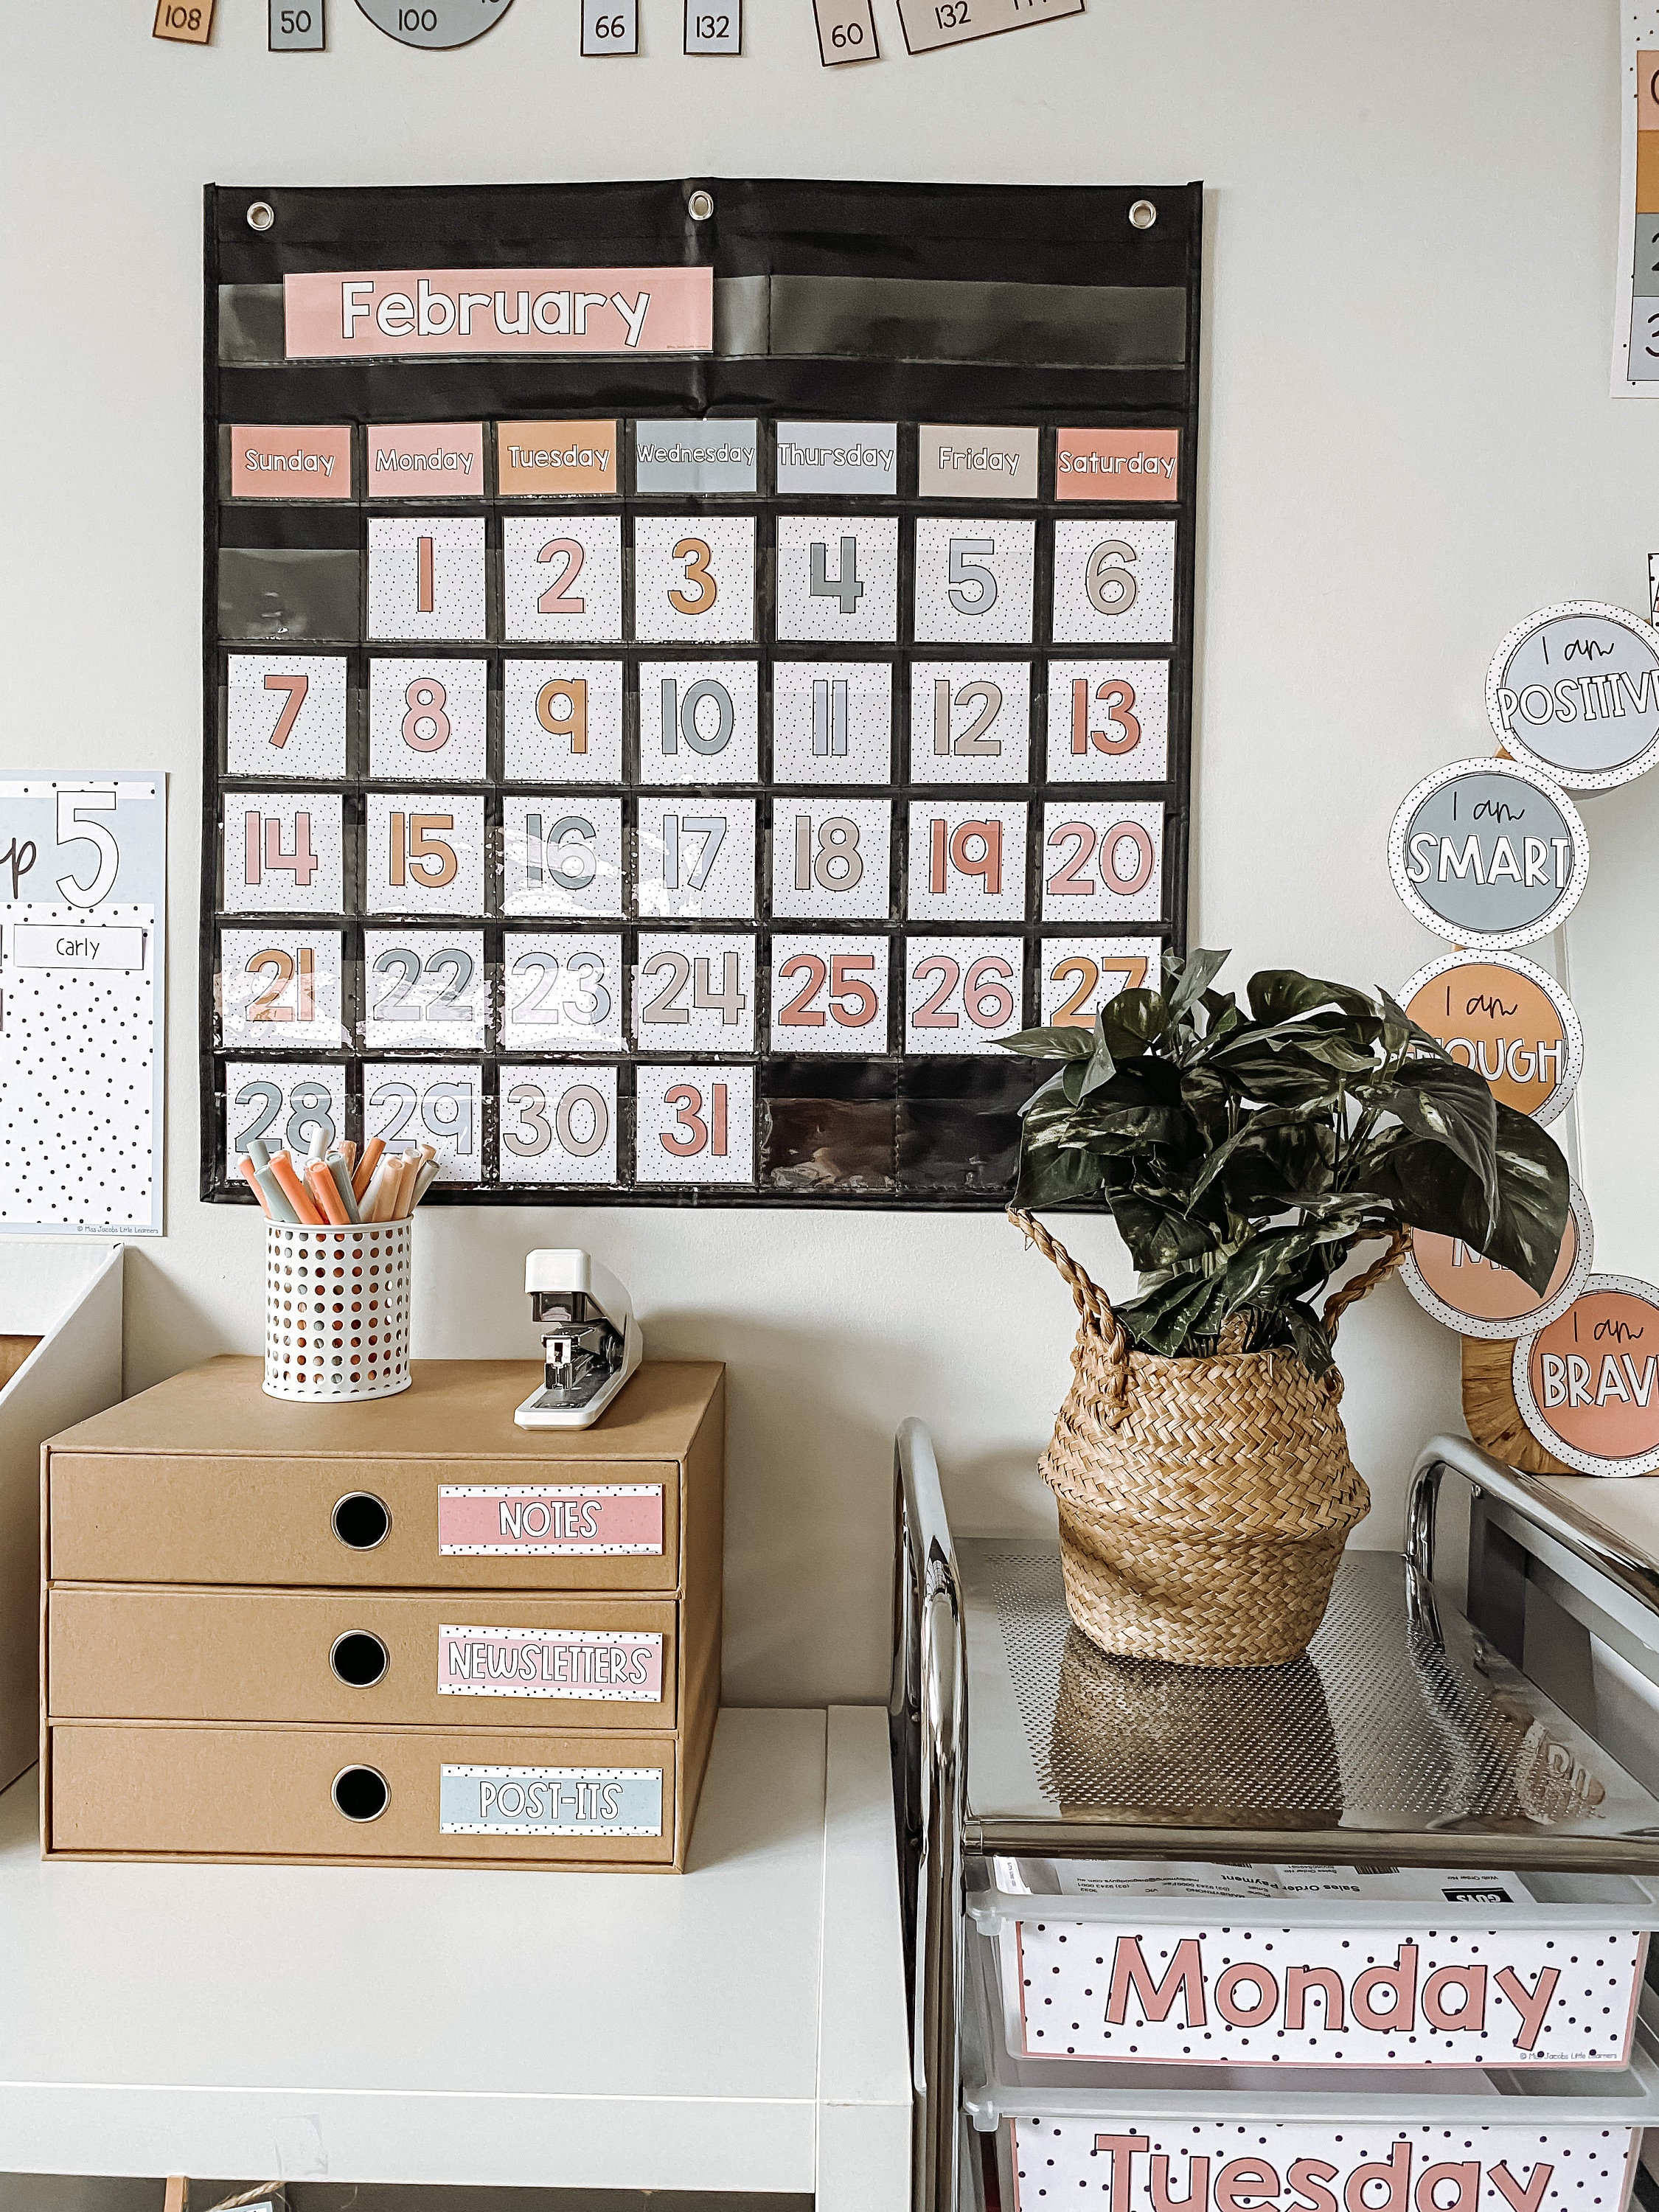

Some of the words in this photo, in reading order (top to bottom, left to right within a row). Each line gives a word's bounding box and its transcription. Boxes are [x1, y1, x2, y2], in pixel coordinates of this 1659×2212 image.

[165, 5, 201, 30] 108
[281, 10, 311, 33] 50
[398, 9, 437, 31] 100
[594, 15, 625, 38] 66
[696, 15, 729, 39] 132
[832, 22, 863, 48] 60
[935, 1, 971, 29] 132
[341, 279, 650, 347] February
[245, 448, 335, 476] Sunday
[375, 448, 473, 474] Monday
[508, 445, 611, 471] Tuesday
[637, 444, 755, 466] Wednesday
[776, 443, 894, 471] Thursday
[939, 446, 1020, 475] Friday
[1059, 451, 1175, 479] Saturday
[417, 537, 433, 612] 1
[537, 538, 586, 613] 2
[667, 538, 717, 615] 3
[810, 536, 863, 613] 4
[947, 538, 998, 615] 5
[1086, 540, 1138, 615] 6
[1542, 636, 1548, 664] I
[1565, 639, 1615, 661] am
[264, 675, 308, 748] 7
[402, 678, 451, 752] 8
[535, 678, 588, 754] 9
[661, 678, 734, 755] 10
[813, 680, 848, 757] 11
[933, 680, 1003, 756] 12
[1071, 678, 1141, 755] 13
[1453, 791, 1458, 821] I
[1473, 800, 1525, 824] am
[56, 791, 119, 908] 5
[245, 811, 318, 886] 14
[389, 812, 457, 888] 15
[526, 814, 597, 891] 16
[663, 815, 726, 891] 17
[795, 815, 863, 891] 18
[929, 819, 1003, 894] 19
[1046, 821, 1155, 895] 20
[1406, 832, 1570, 888] SMART
[57, 938, 100, 960] Carly
[245, 948, 315, 1022] 21
[372, 948, 476, 1021] 22
[511, 952, 612, 1025] 23
[642, 951, 745, 1025] 24
[778, 954, 879, 1027] 25
[912, 956, 1014, 1029] 26
[1446, 985, 1451, 1016] I
[1467, 995, 1518, 1019] am
[1401, 1037, 1564, 1085] OUGH
[234, 1081, 336, 1155] 28
[369, 1082, 473, 1155] 29
[503, 1084, 609, 1157] 30
[659, 1084, 727, 1156] 31
[1573, 1311, 1579, 1343] I
[1593, 1319, 1644, 1343] am
[1540, 1353, 1659, 1408] BRAV
[499, 1500, 602, 1539] NOTES
[448, 1641, 653, 1685] NEWSLETTERS
[480, 1781, 624, 1820] POST-ITS
[1221, 1874, 1279, 1890] Payment
[1105, 1936, 1562, 2051] Monday
[1094, 2133, 1554, 2212] Tuesday
